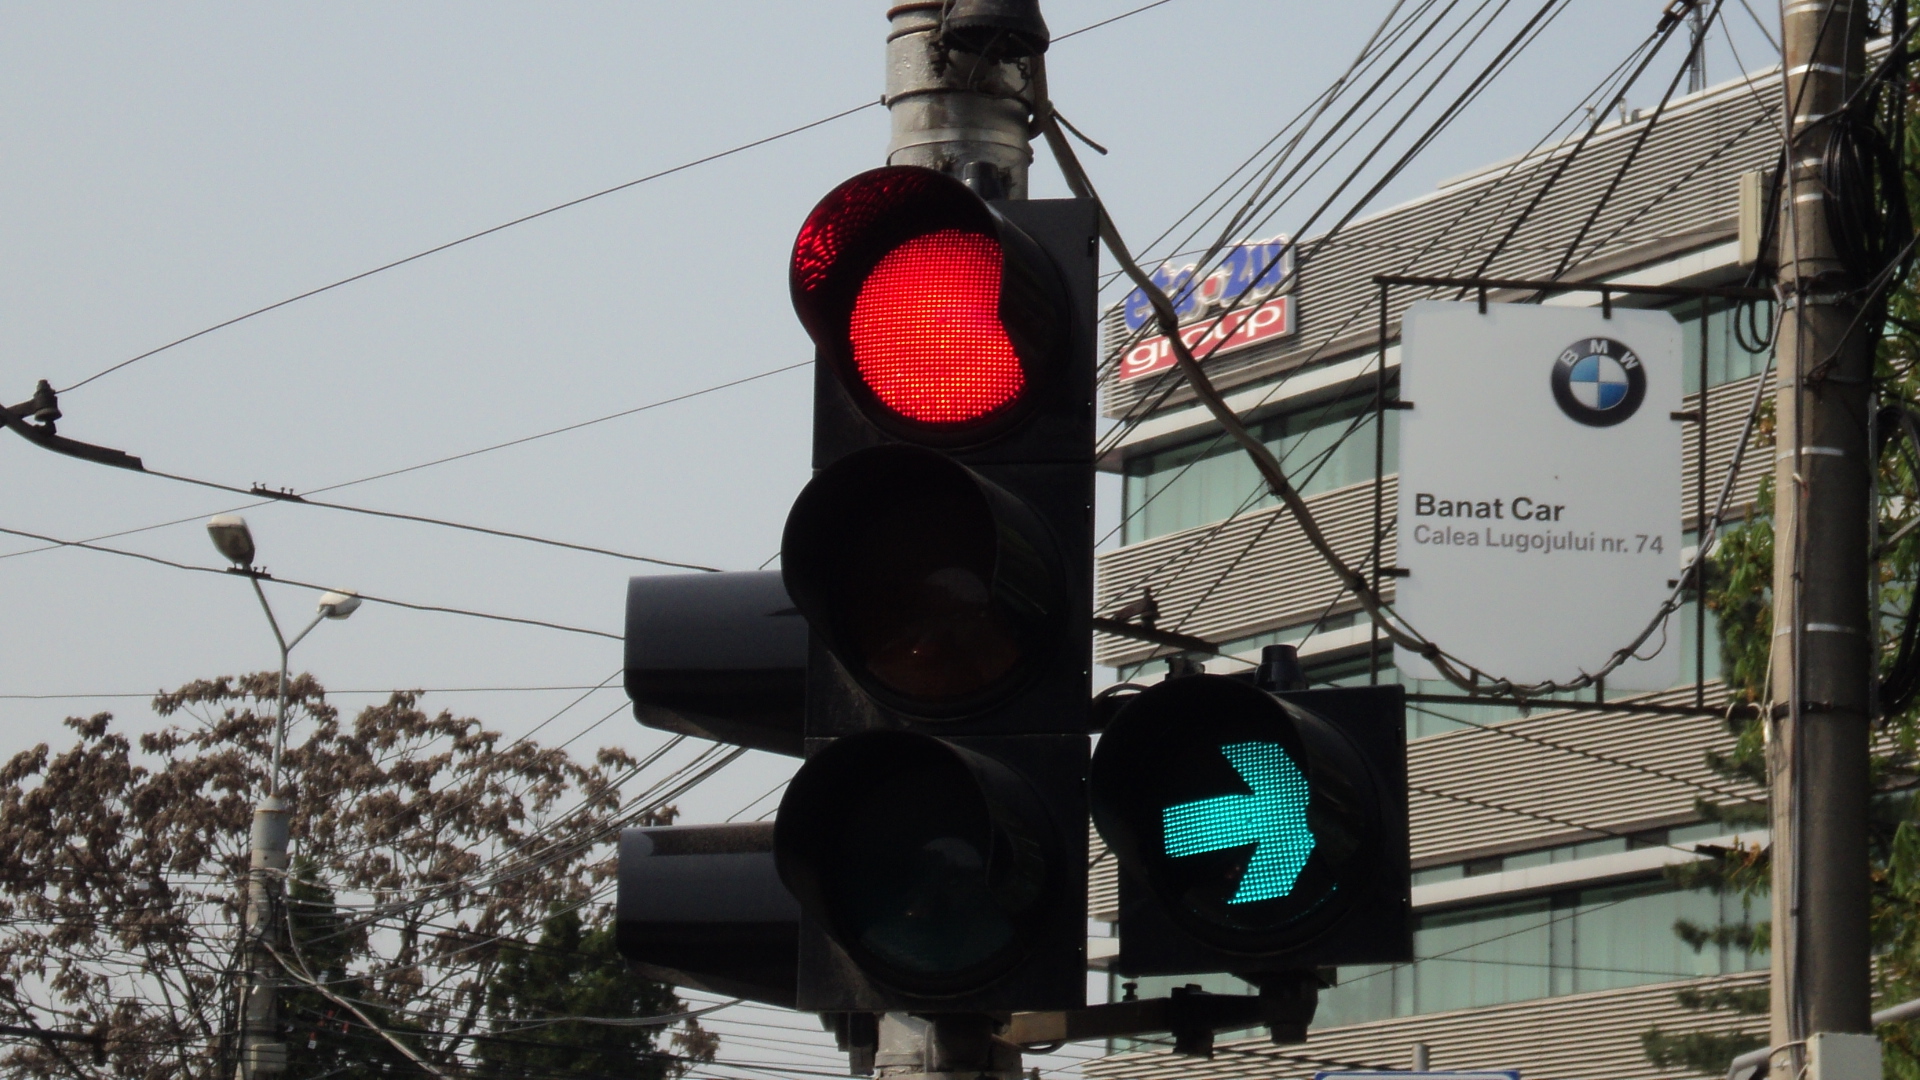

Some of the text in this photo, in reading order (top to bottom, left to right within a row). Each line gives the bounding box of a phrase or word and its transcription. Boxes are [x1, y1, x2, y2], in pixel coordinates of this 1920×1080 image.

[1126, 305, 1282, 374] group
[1560, 339, 1639, 370] BMW
[1415, 493, 1565, 522] Banat Car
[1413, 524, 1664, 554] Calea Lugojului nr. 74
